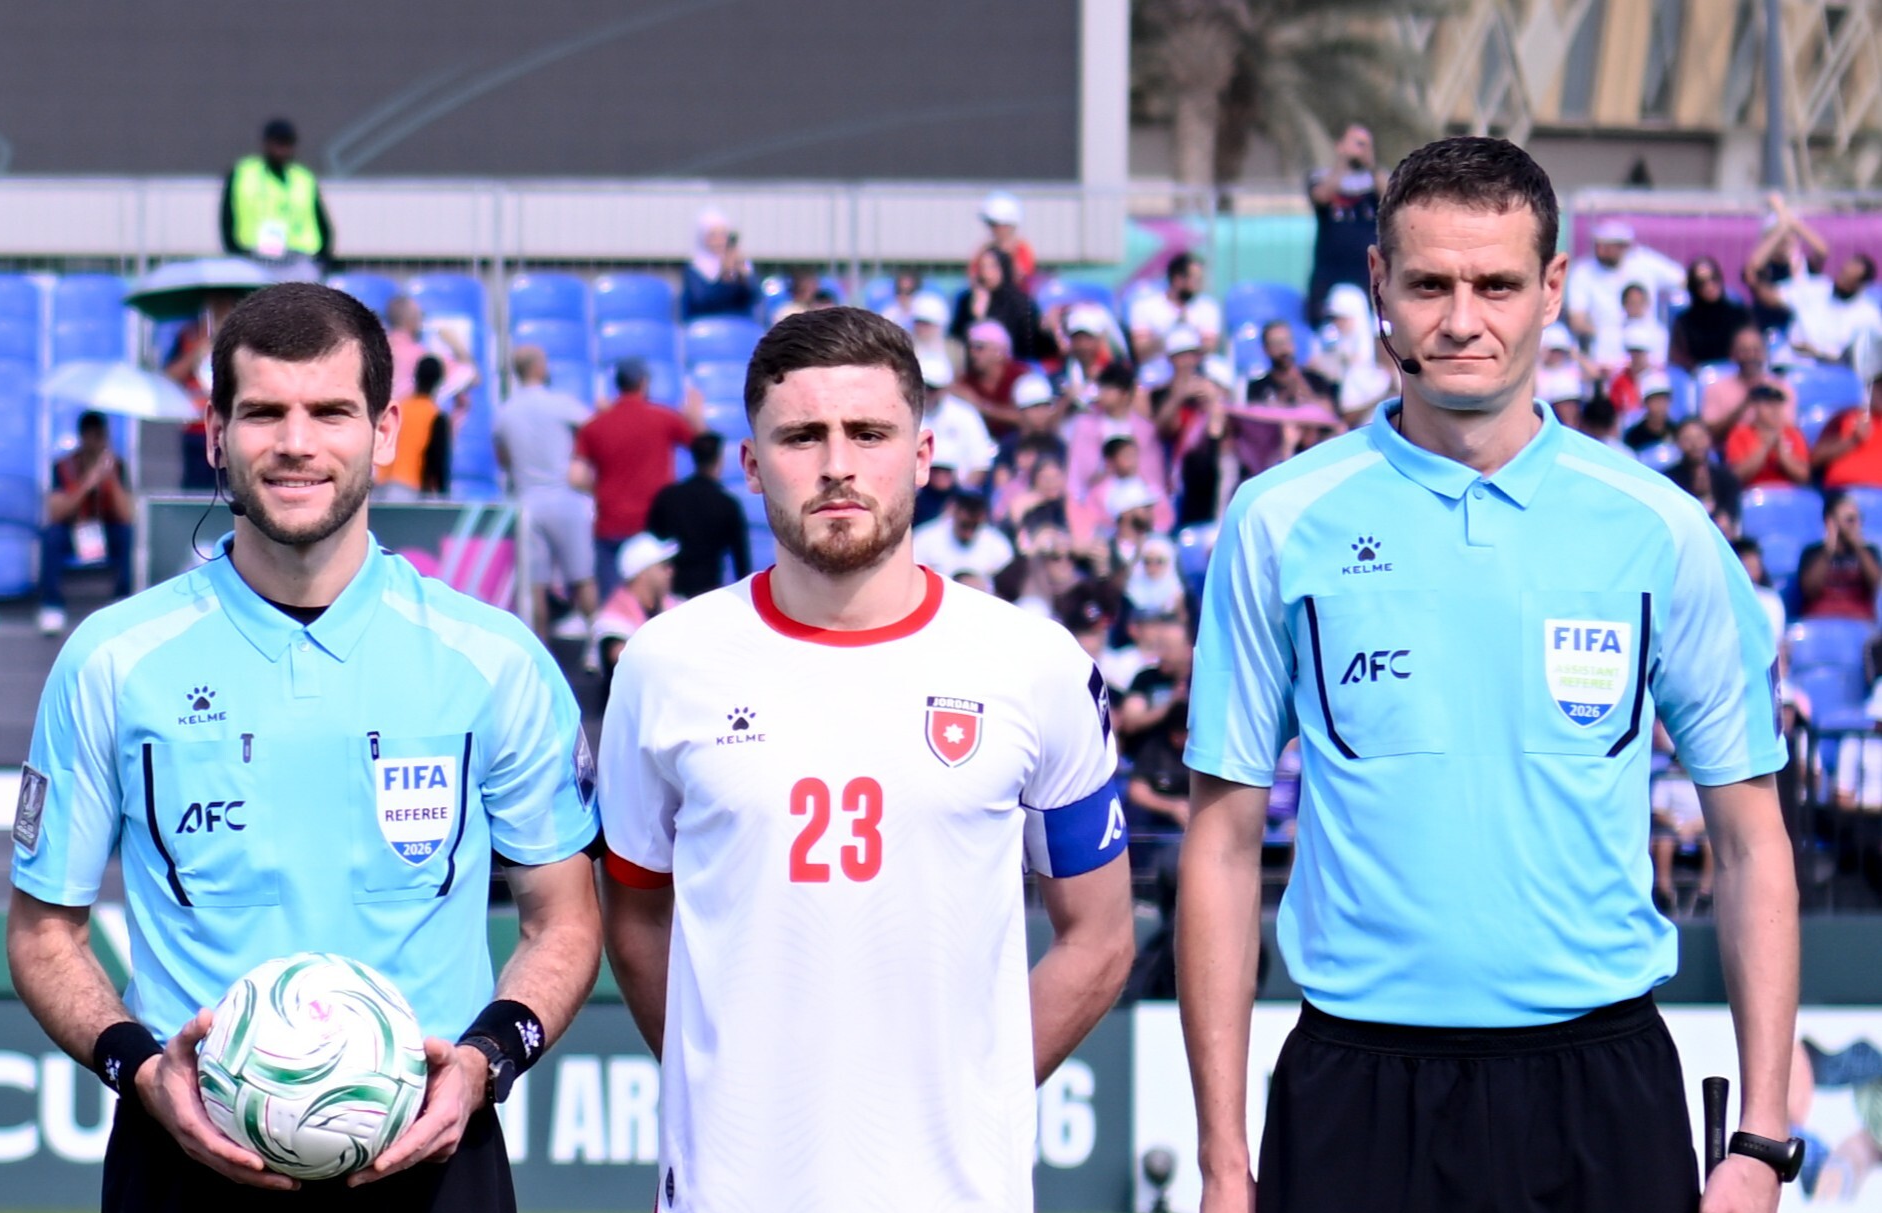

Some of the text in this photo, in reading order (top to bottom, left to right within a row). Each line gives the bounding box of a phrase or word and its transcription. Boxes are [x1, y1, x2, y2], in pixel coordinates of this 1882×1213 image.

[1342, 563, 1393, 575] KELME
[1554, 627, 1622, 654] FIFA
[1340, 650, 1412, 685] AFC
[1560, 676, 1614, 689] REFEREE
[933, 697, 979, 712] JORDAN
[1568, 705, 1601, 718] 2026
[178, 711, 227, 725] KELME
[716, 733, 766, 746] KELME
[384, 765, 448, 791] FIFA
[175, 801, 247, 834] AFC
[385, 807, 448, 822] REFEREE
[789, 776, 883, 883] 23
[403, 843, 432, 856] 2026
